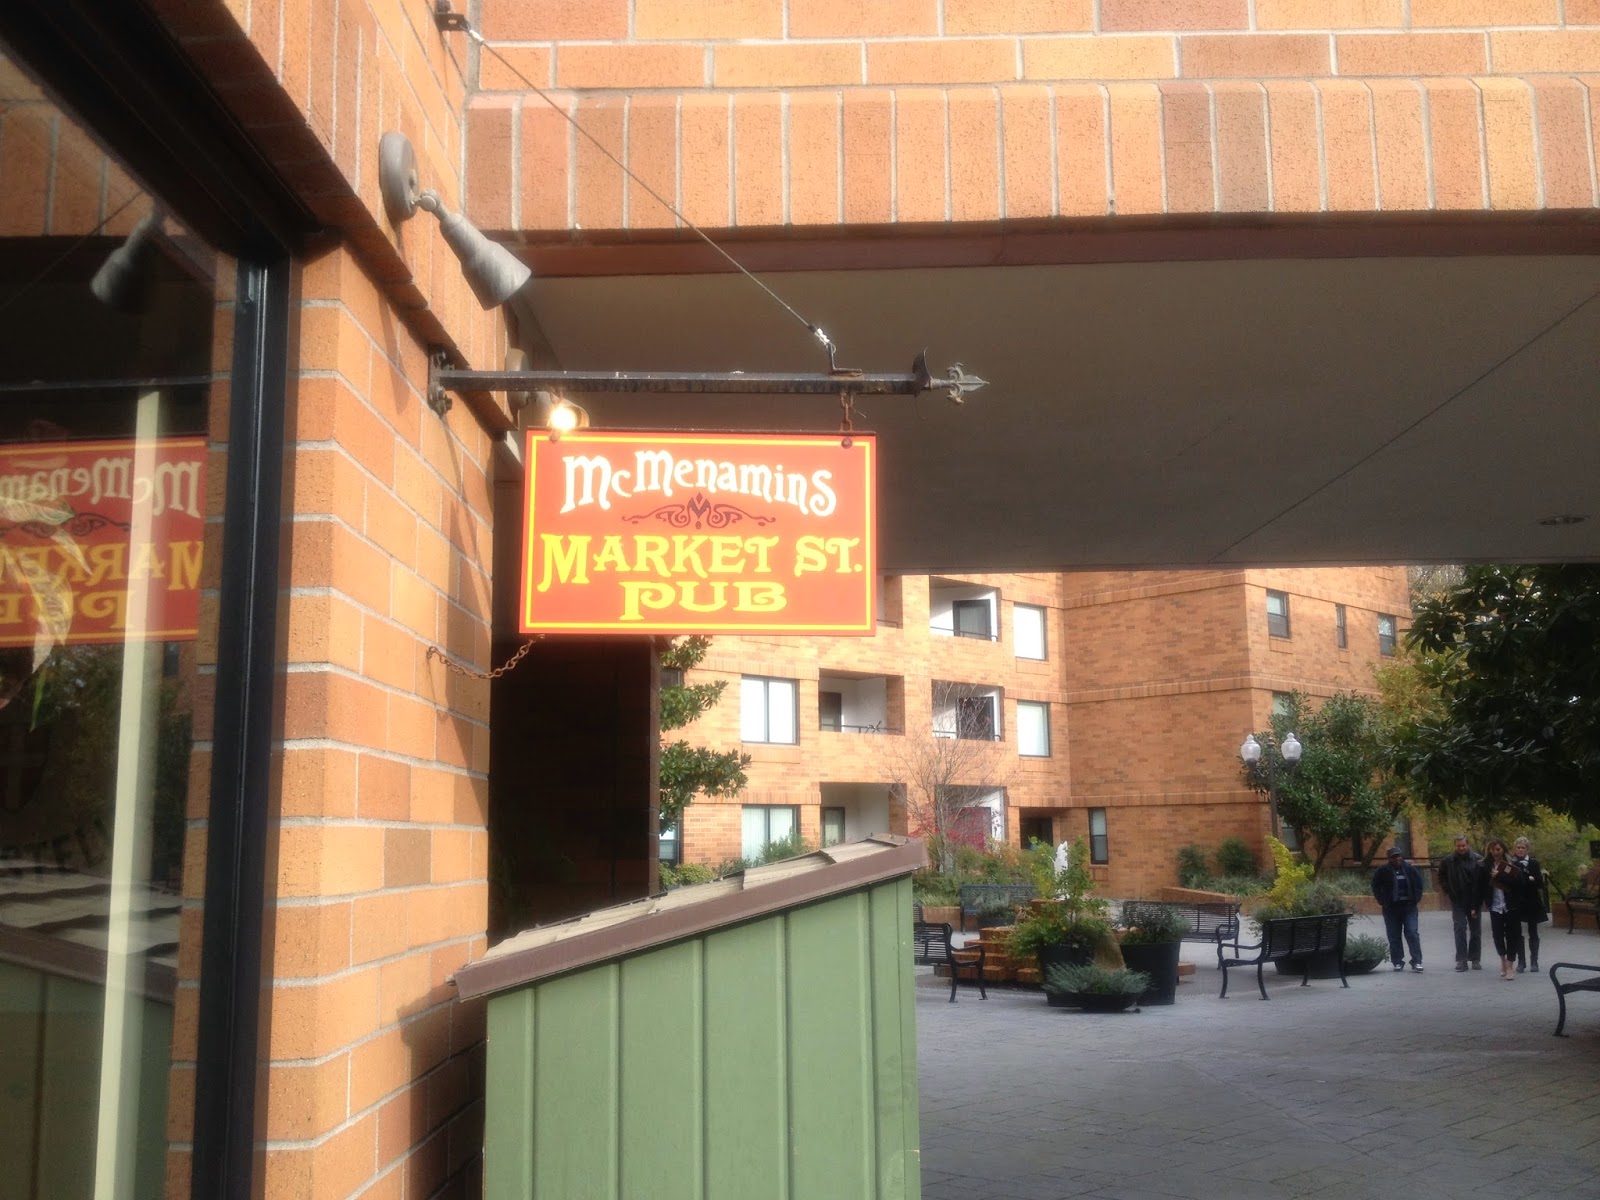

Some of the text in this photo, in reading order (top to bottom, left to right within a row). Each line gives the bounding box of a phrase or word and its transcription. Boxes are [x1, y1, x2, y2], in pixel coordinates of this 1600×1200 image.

[559, 449, 837, 516] McMenamins
[537, 533, 863, 592] MARKET ST.
[619, 581, 788, 621] PUB
